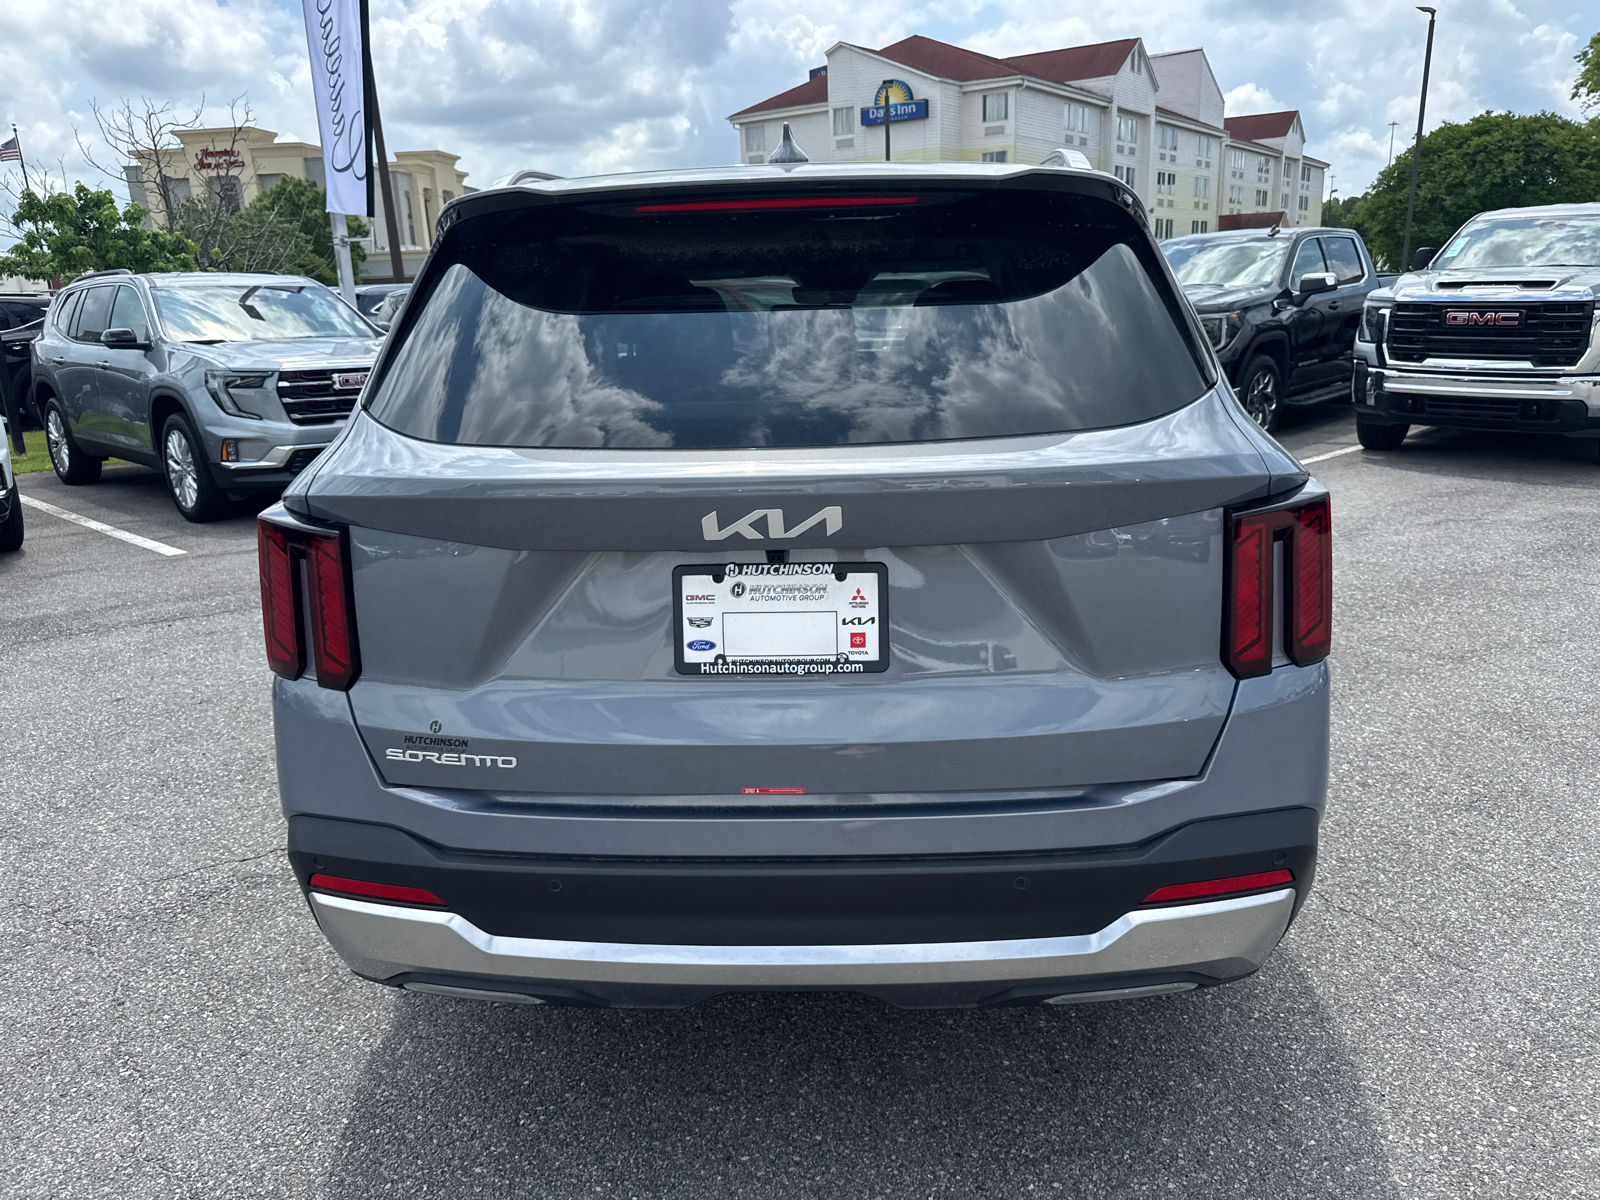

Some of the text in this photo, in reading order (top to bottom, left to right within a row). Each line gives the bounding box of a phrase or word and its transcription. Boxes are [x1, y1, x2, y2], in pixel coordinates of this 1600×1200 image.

[869, 105, 896, 119] Das
[897, 104, 916, 115] Inn
[1446, 312, 1520, 325] GMC
[702, 505, 843, 541] KIA
[742, 563, 834, 576] HUTCHINSON
[748, 583, 828, 595] HUTCHINSON
[750, 594, 797, 602] AUTOMOTIVE
[842, 616, 876, 626] KIA
[692, 641, 711, 650] Ford
[700, 662, 864, 675] Hutchinsonautogroup.com
[404, 735, 469, 748] HUTCHINSON
[405, 744, 444, 753] AUTOMOTIVE
[385, 748, 517, 769] SORENTO
